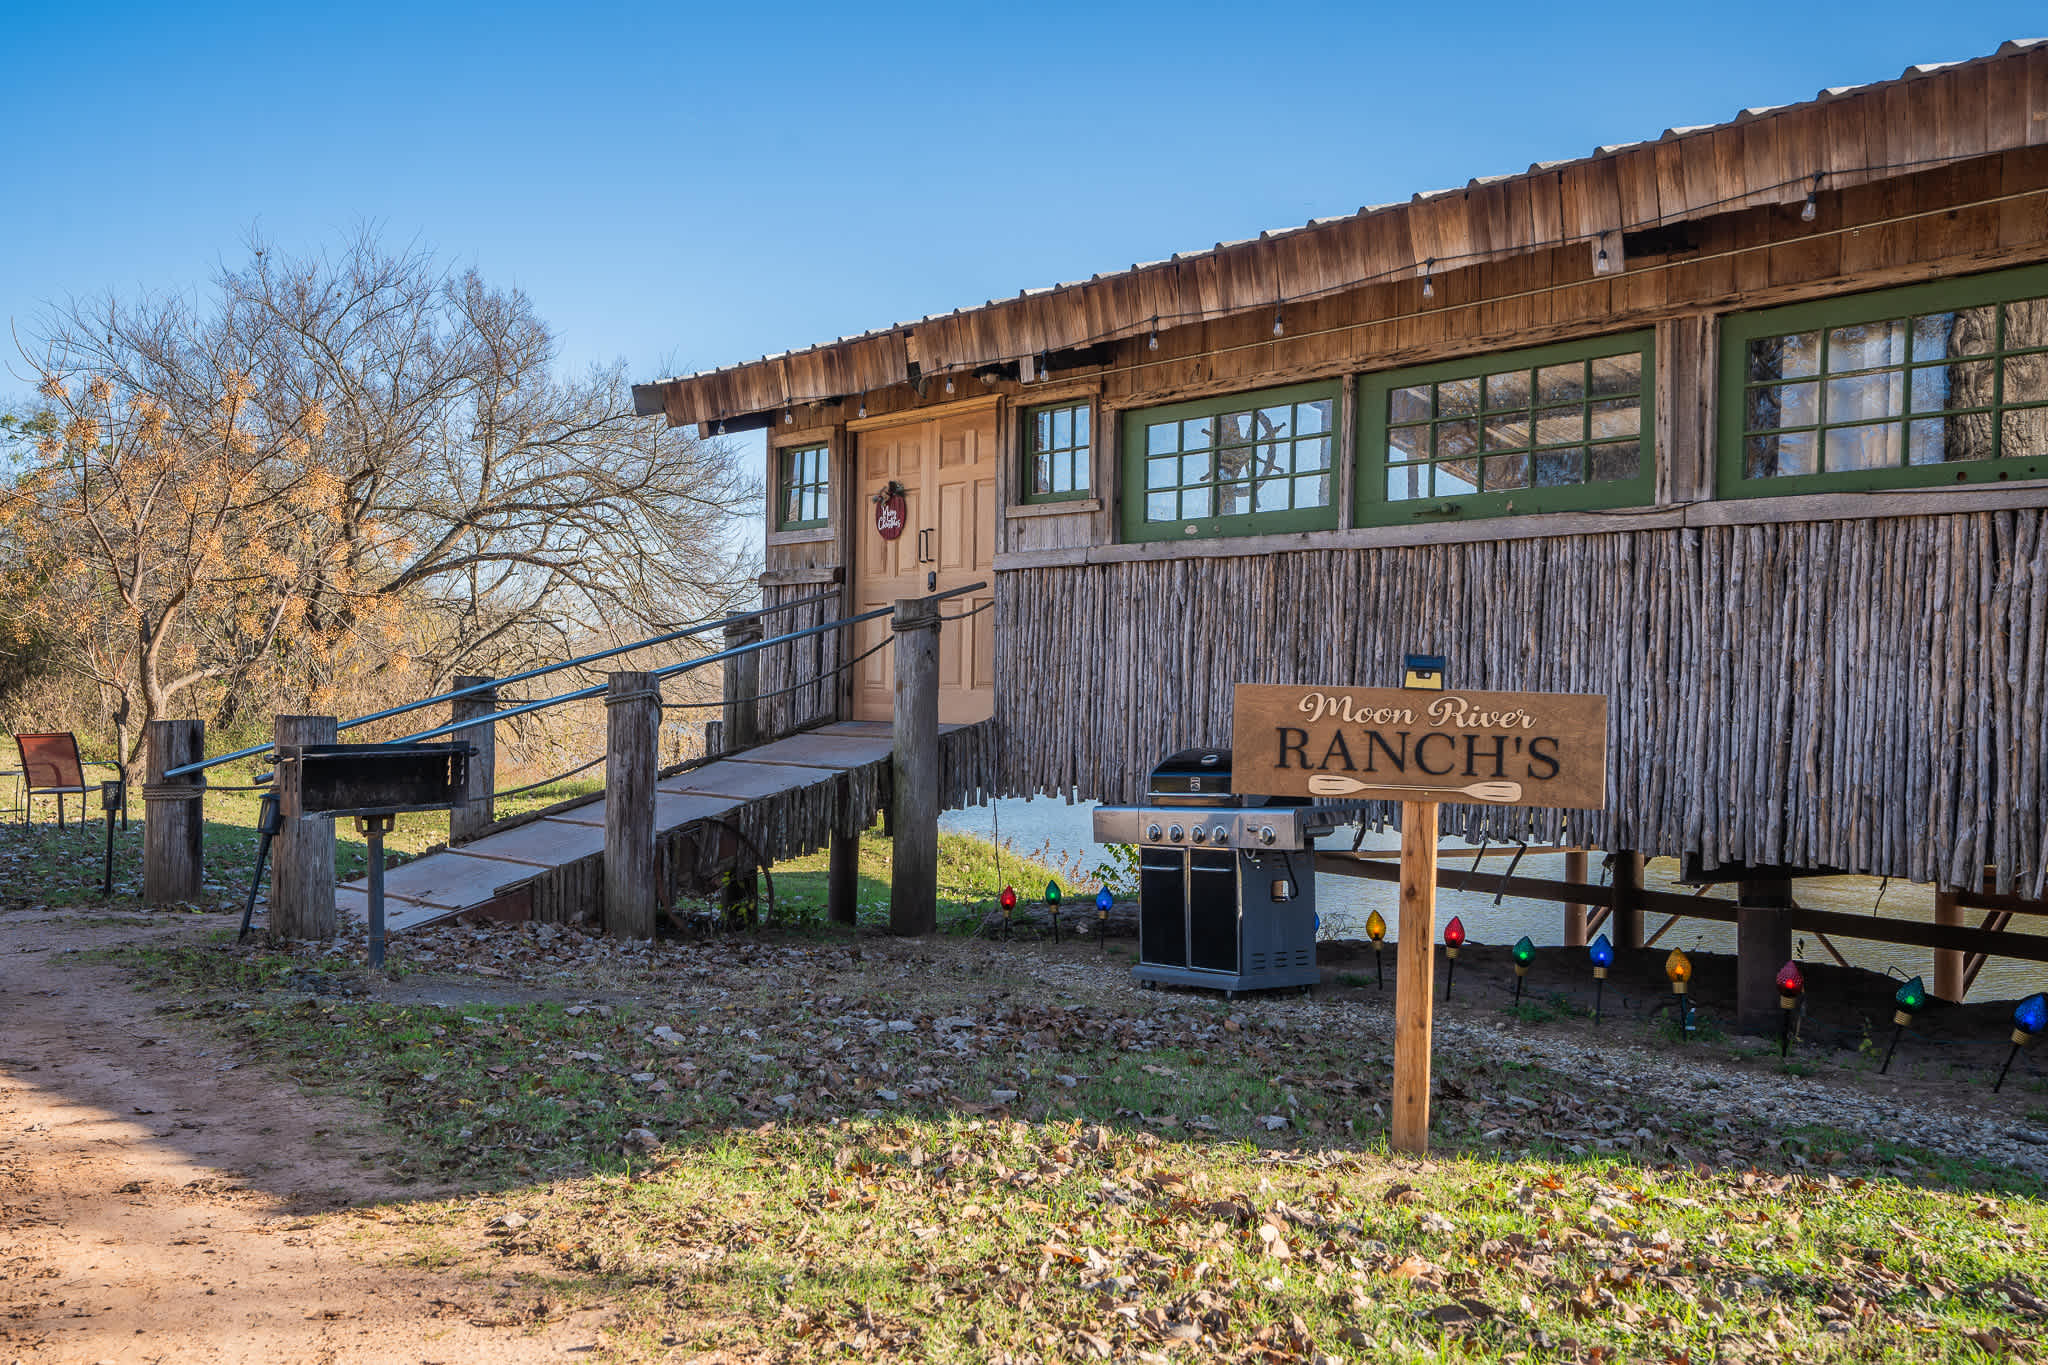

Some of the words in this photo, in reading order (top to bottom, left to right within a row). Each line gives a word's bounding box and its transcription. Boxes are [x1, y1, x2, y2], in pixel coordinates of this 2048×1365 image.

[1299, 692, 1418, 724] Moon
[1427, 696, 1537, 729] River
[1274, 727, 1561, 780] RANCH'S
